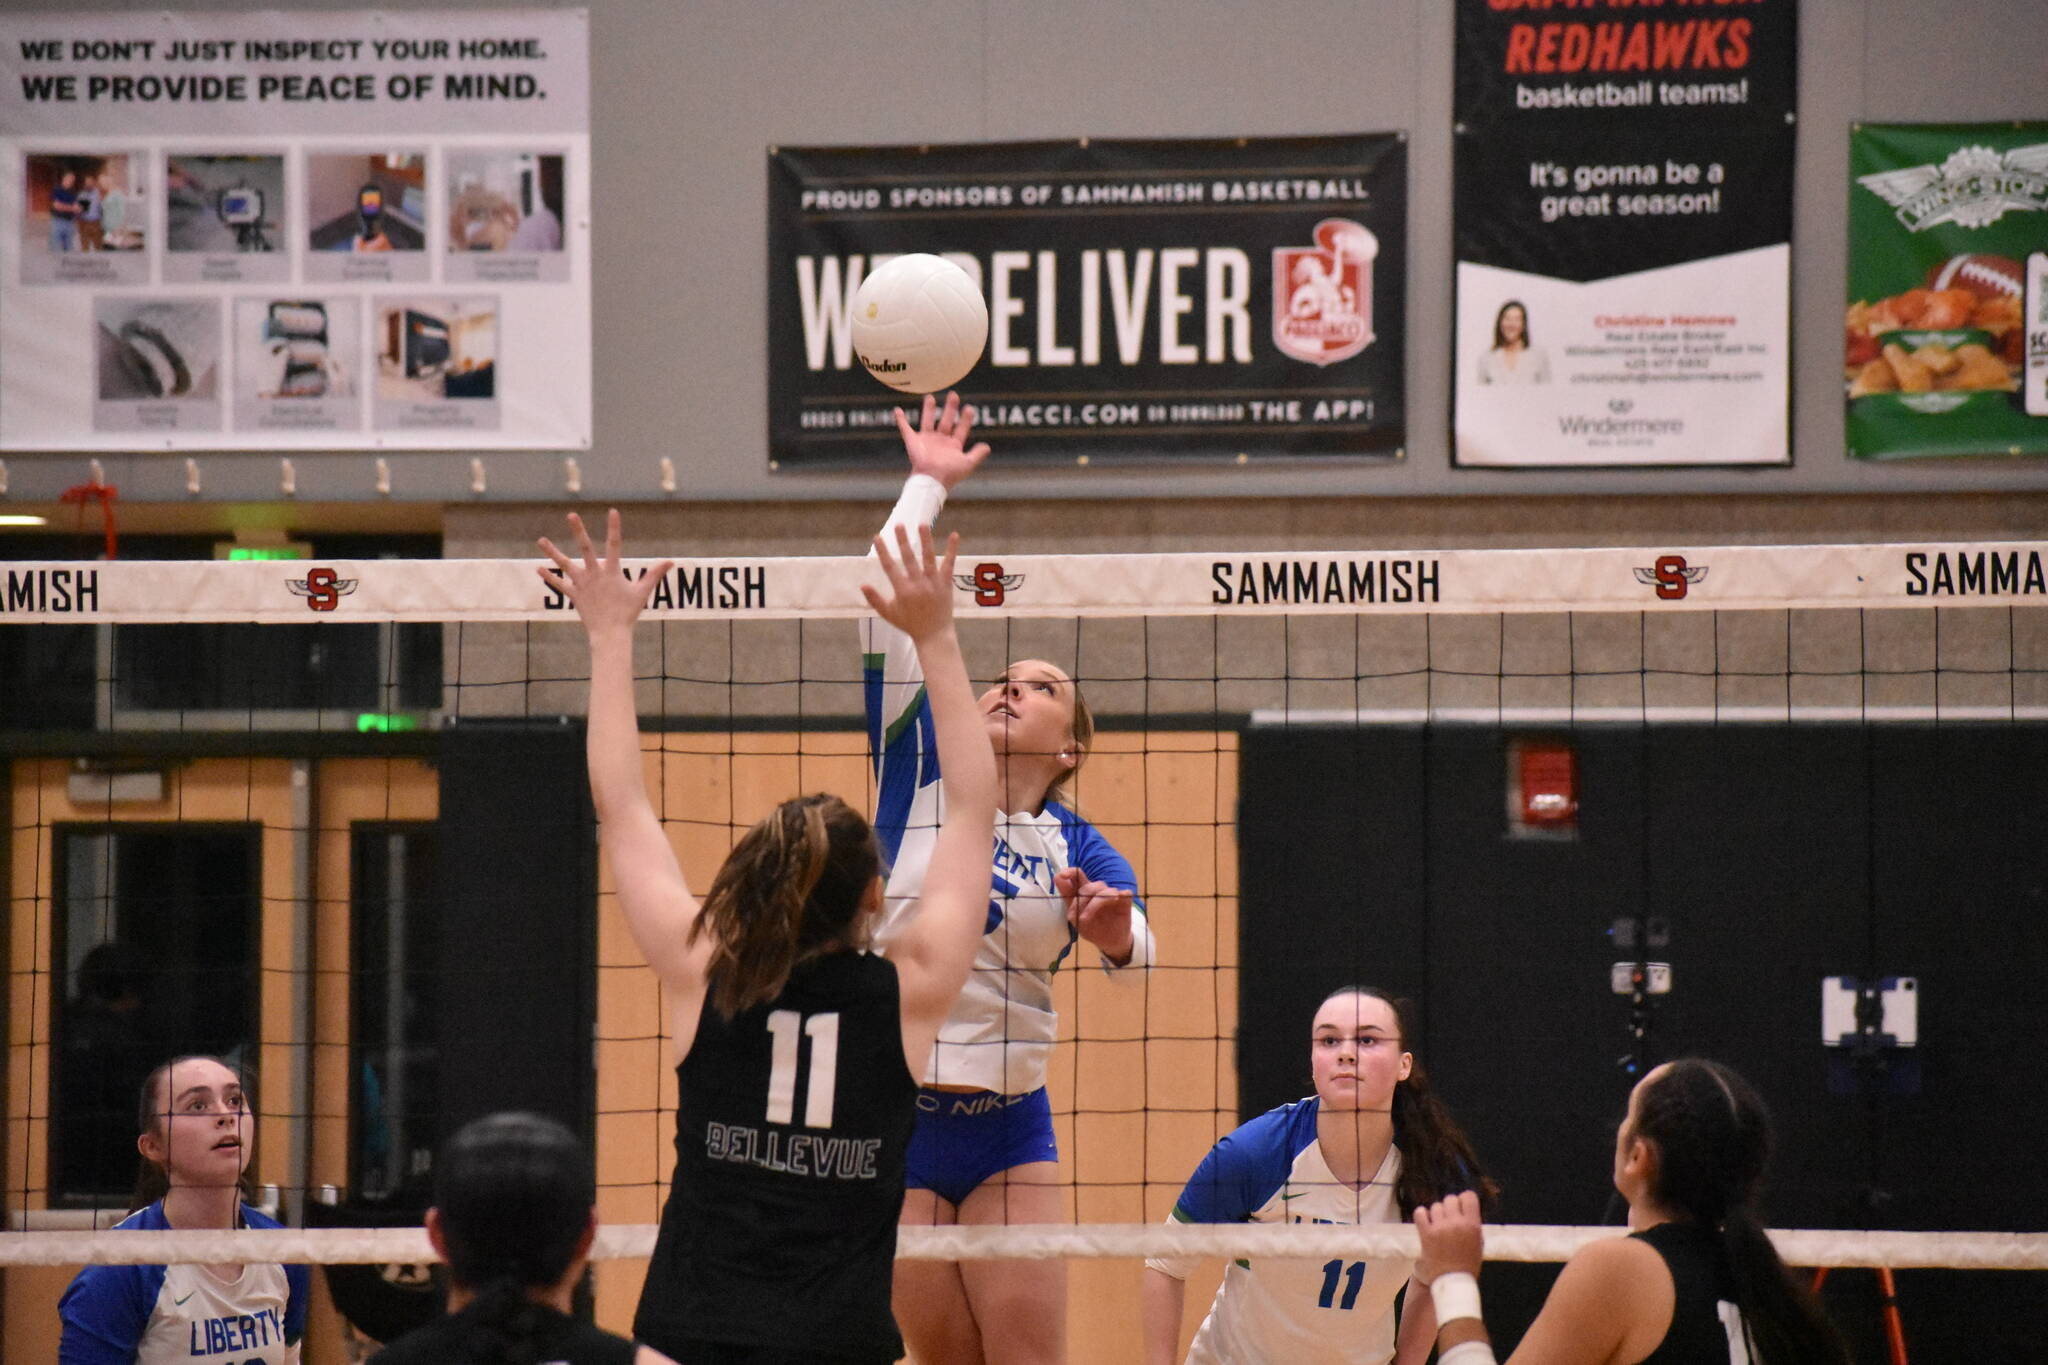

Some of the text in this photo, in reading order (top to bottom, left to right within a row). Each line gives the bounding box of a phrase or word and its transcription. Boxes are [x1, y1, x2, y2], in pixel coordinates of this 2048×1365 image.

[20, 39, 547, 60] WE DON'T JUST INSPECT YOUR HOME.
[1504, 17, 1752, 74] REDHAWKS
[21, 75, 546, 101] WE PROVIDE PEACE OF MIND.
[1516, 78, 1749, 109] basketball teams!
[801, 188, 881, 210] PROUD
[890, 186, 1013, 208] SPONSORS
[1021, 185, 1051, 206] OF
[1212, 179, 1369, 201] BASKETBALL
[1529, 158, 1724, 193] It's gonna be a
[1540, 187, 1720, 223] great season!
[938, 248, 1252, 367] ELIVER
[934, 403, 1140, 427] LIACCI.COM
[1250, 400, 1302, 423] THE
[1313, 399, 1374, 422] APP!
[1558, 415, 1684, 437] Windermere
[0, 570, 98, 612] MISH
[307, 568, 338, 611] S
[544, 566, 765, 610] SAMISH
[975, 563, 1005, 607] S
[1212, 560, 1439, 605] SAMMAMISH
[1655, 555, 1688, 600] S
[1906, 551, 2047, 596] SAMMA
[765, 1009, 839, 1130] 11
[705, 1121, 882, 1179] BELLEVUE
[1318, 1259, 1376, 1310] 11
[190, 1306, 281, 1356] LIBERTY
